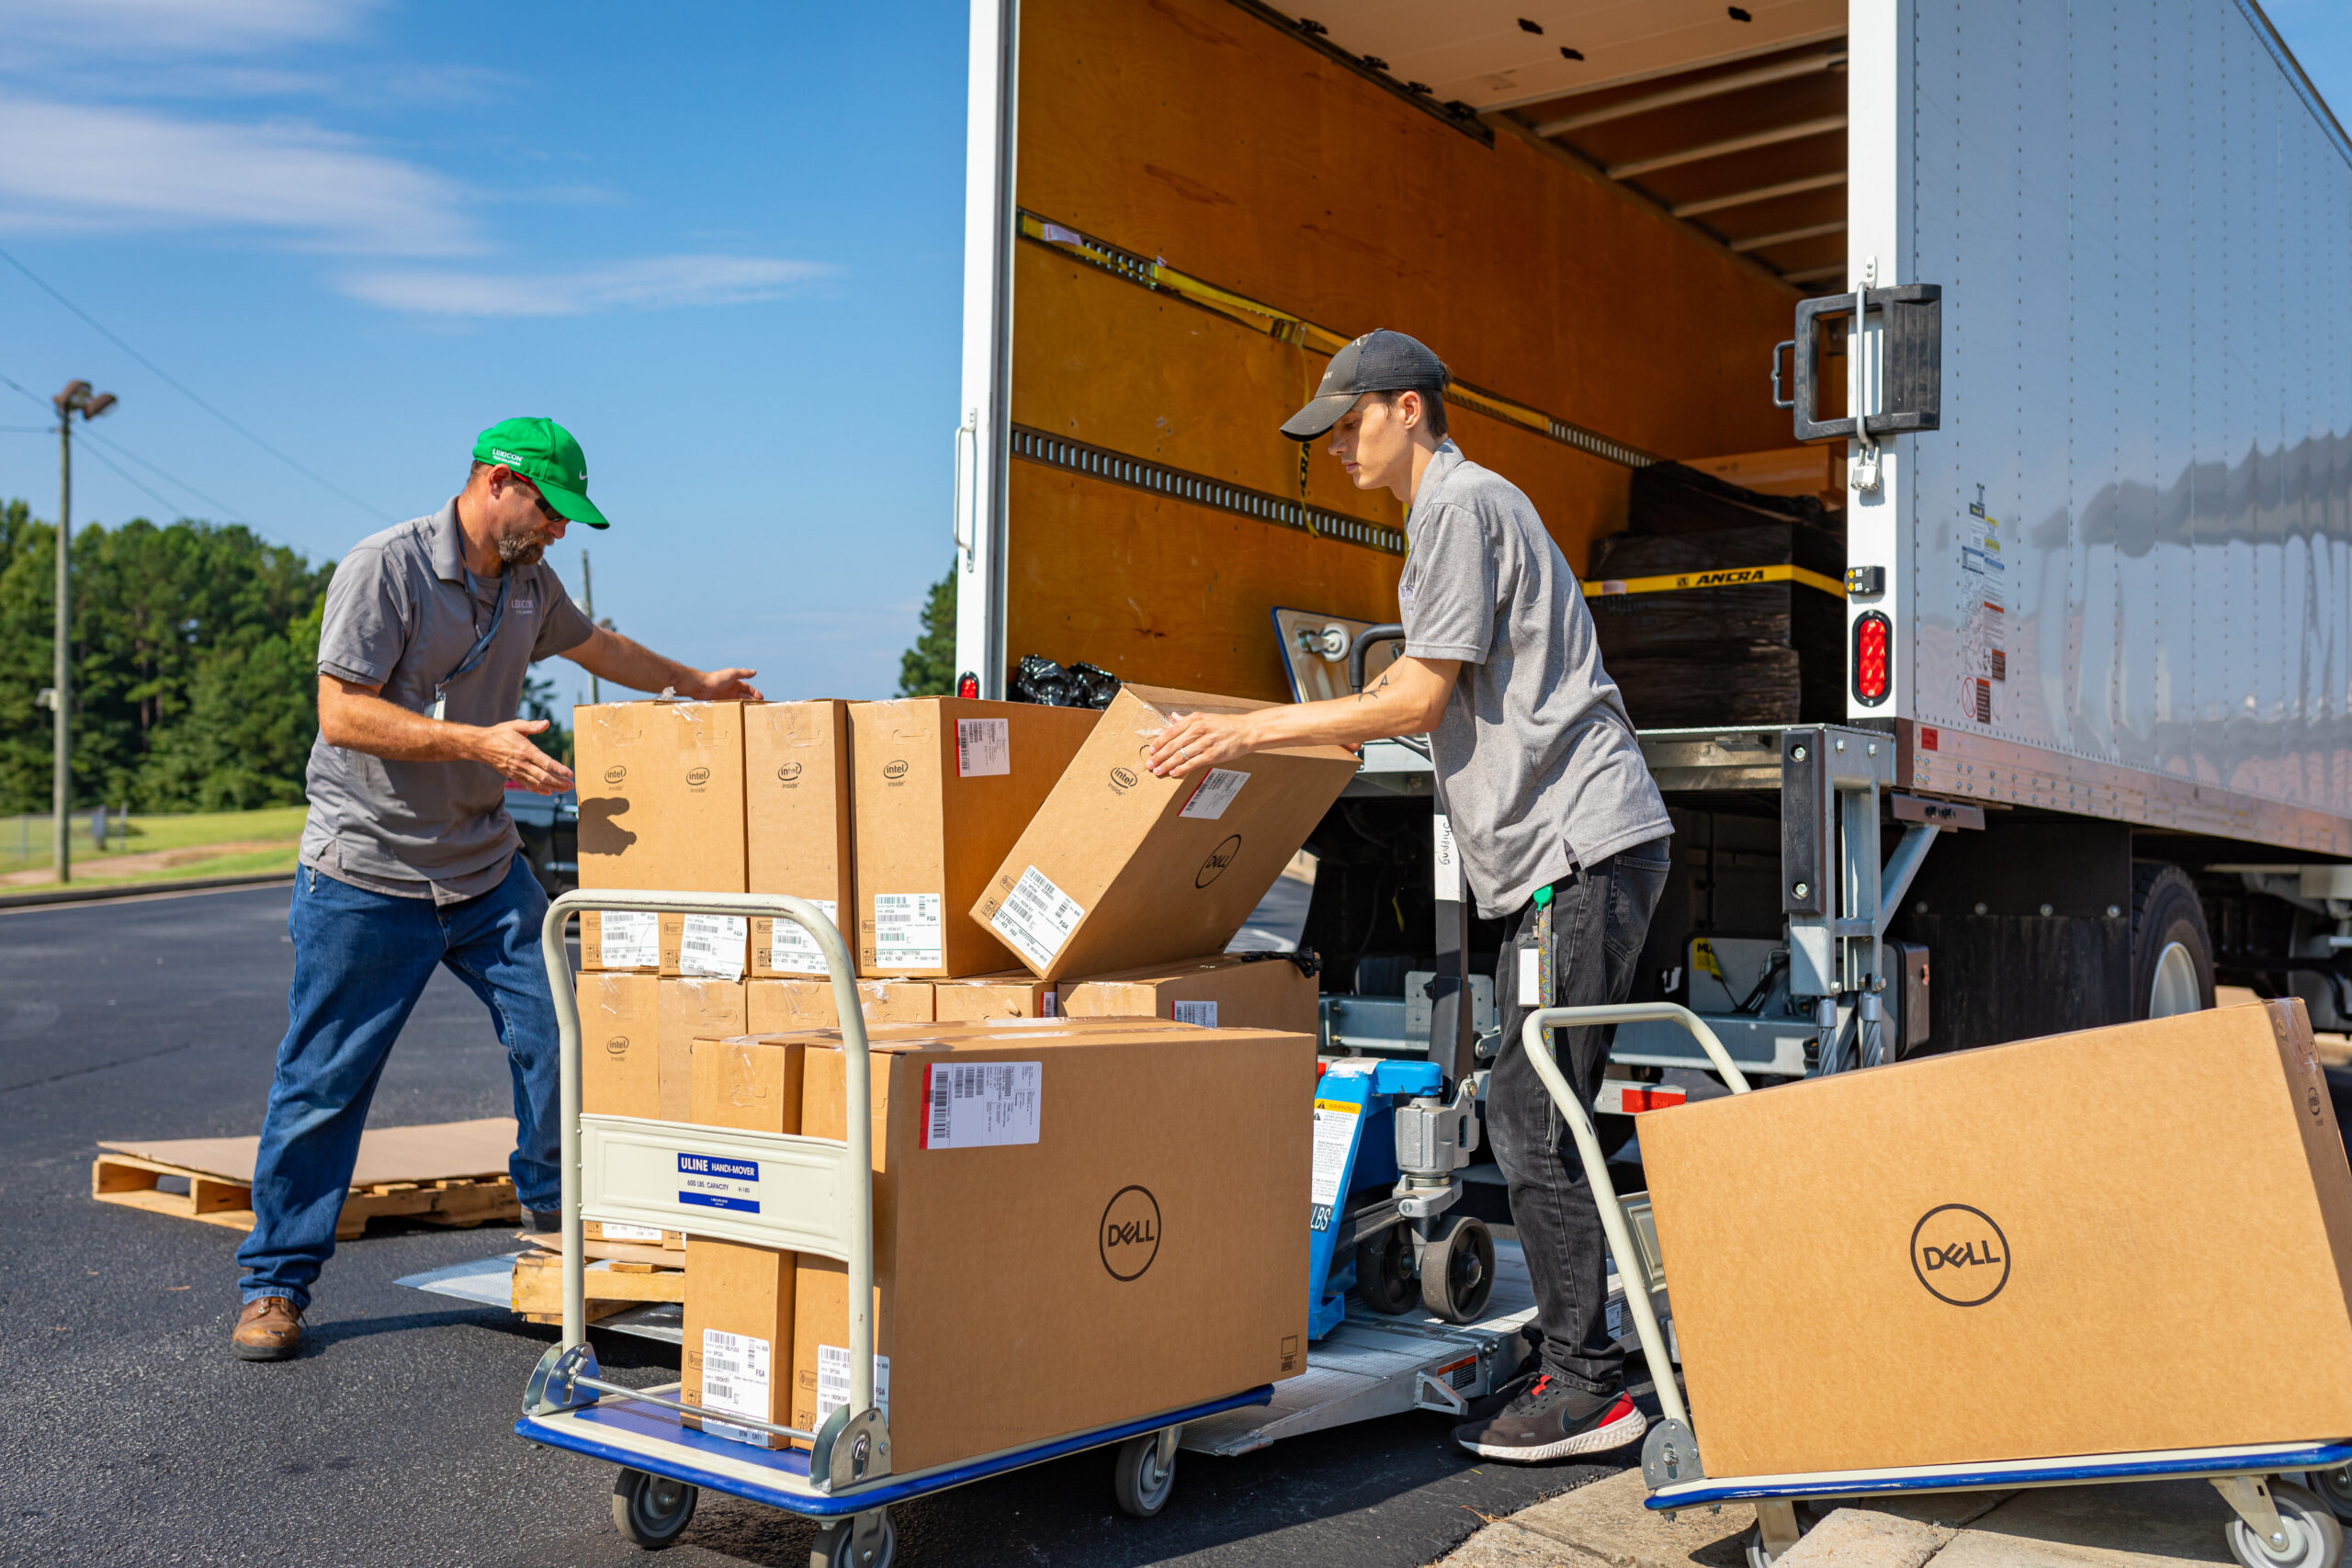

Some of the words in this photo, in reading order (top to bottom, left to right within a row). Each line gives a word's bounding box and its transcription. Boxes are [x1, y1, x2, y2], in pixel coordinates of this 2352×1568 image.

[1696, 570, 1765, 586] ANCRA
[607, 769, 624, 779] intel
[886, 763, 905, 773] intel
[689, 771, 707, 781] intel
[1114, 767, 1134, 785] intel
[1058, 919, 1069, 931] FGA
[681, 1156, 708, 1172] ULINE
[711, 1162, 755, 1176] HANDI-MOVER
[707, 1181, 729, 1191] CAPACITY
[1310, 1205, 1330, 1231] LBS
[1108, 1219, 1155, 1247] DELL
[1923, 1239, 2001, 1271] DELL
[756, 1369, 765, 1378] FGA
[876, 1386, 885, 1396] FGA
